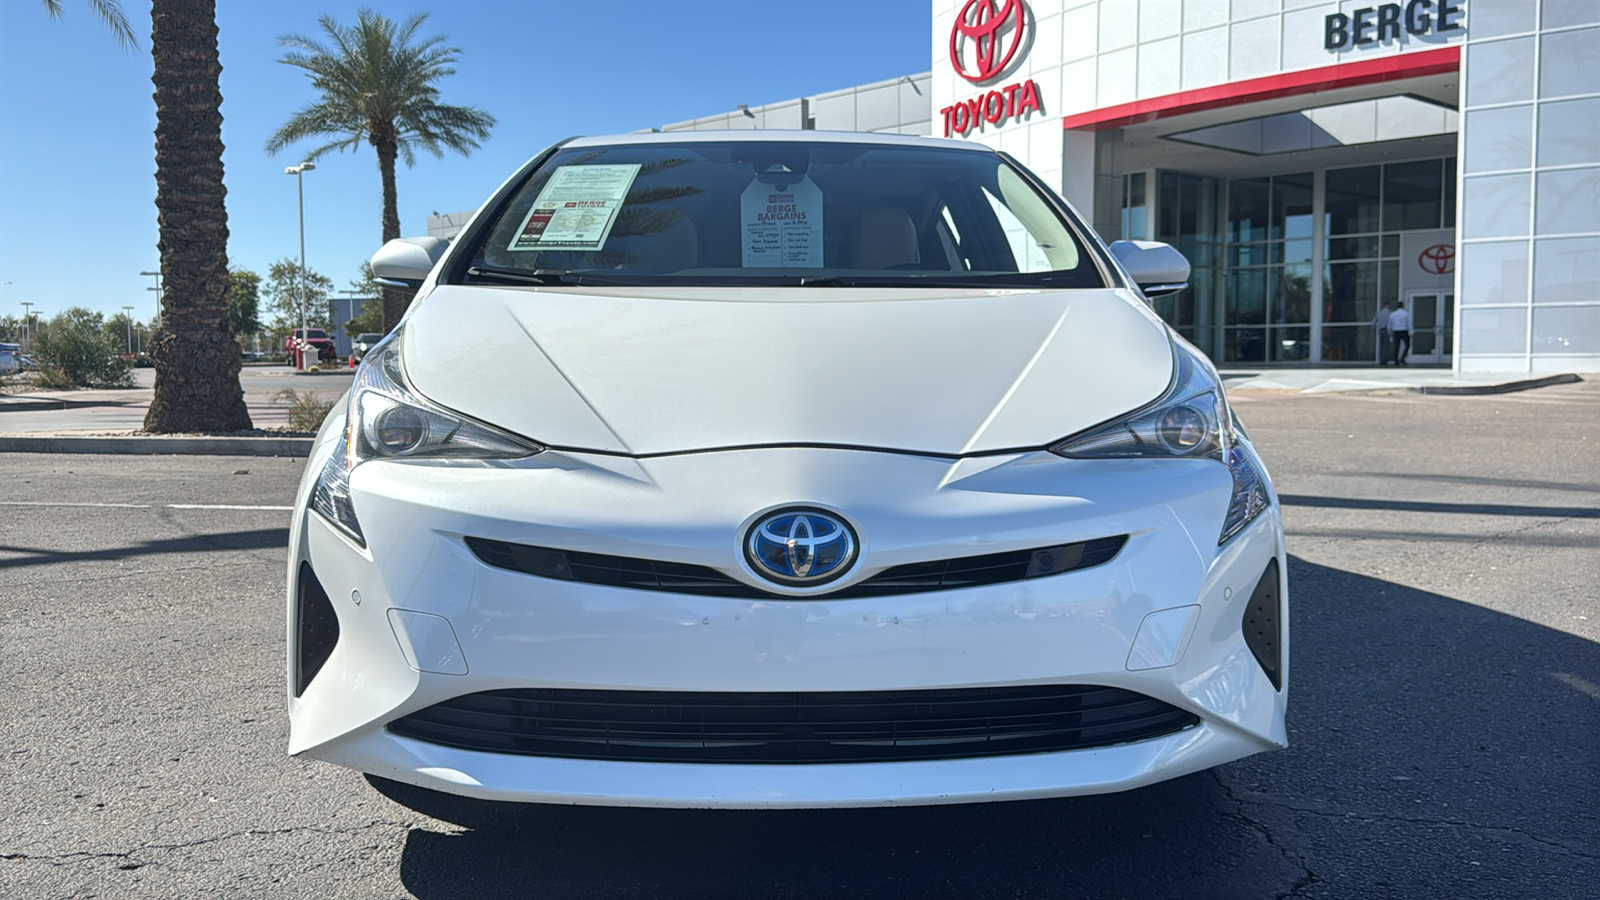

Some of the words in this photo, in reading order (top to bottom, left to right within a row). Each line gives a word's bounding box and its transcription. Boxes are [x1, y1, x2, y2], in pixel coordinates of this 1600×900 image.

[1325, 0, 1459, 49] BERGE
[940, 79, 1040, 138] TOYOTA
[757, 212, 807, 220] BARGAINS
[767, 205, 797, 213] BERGE
